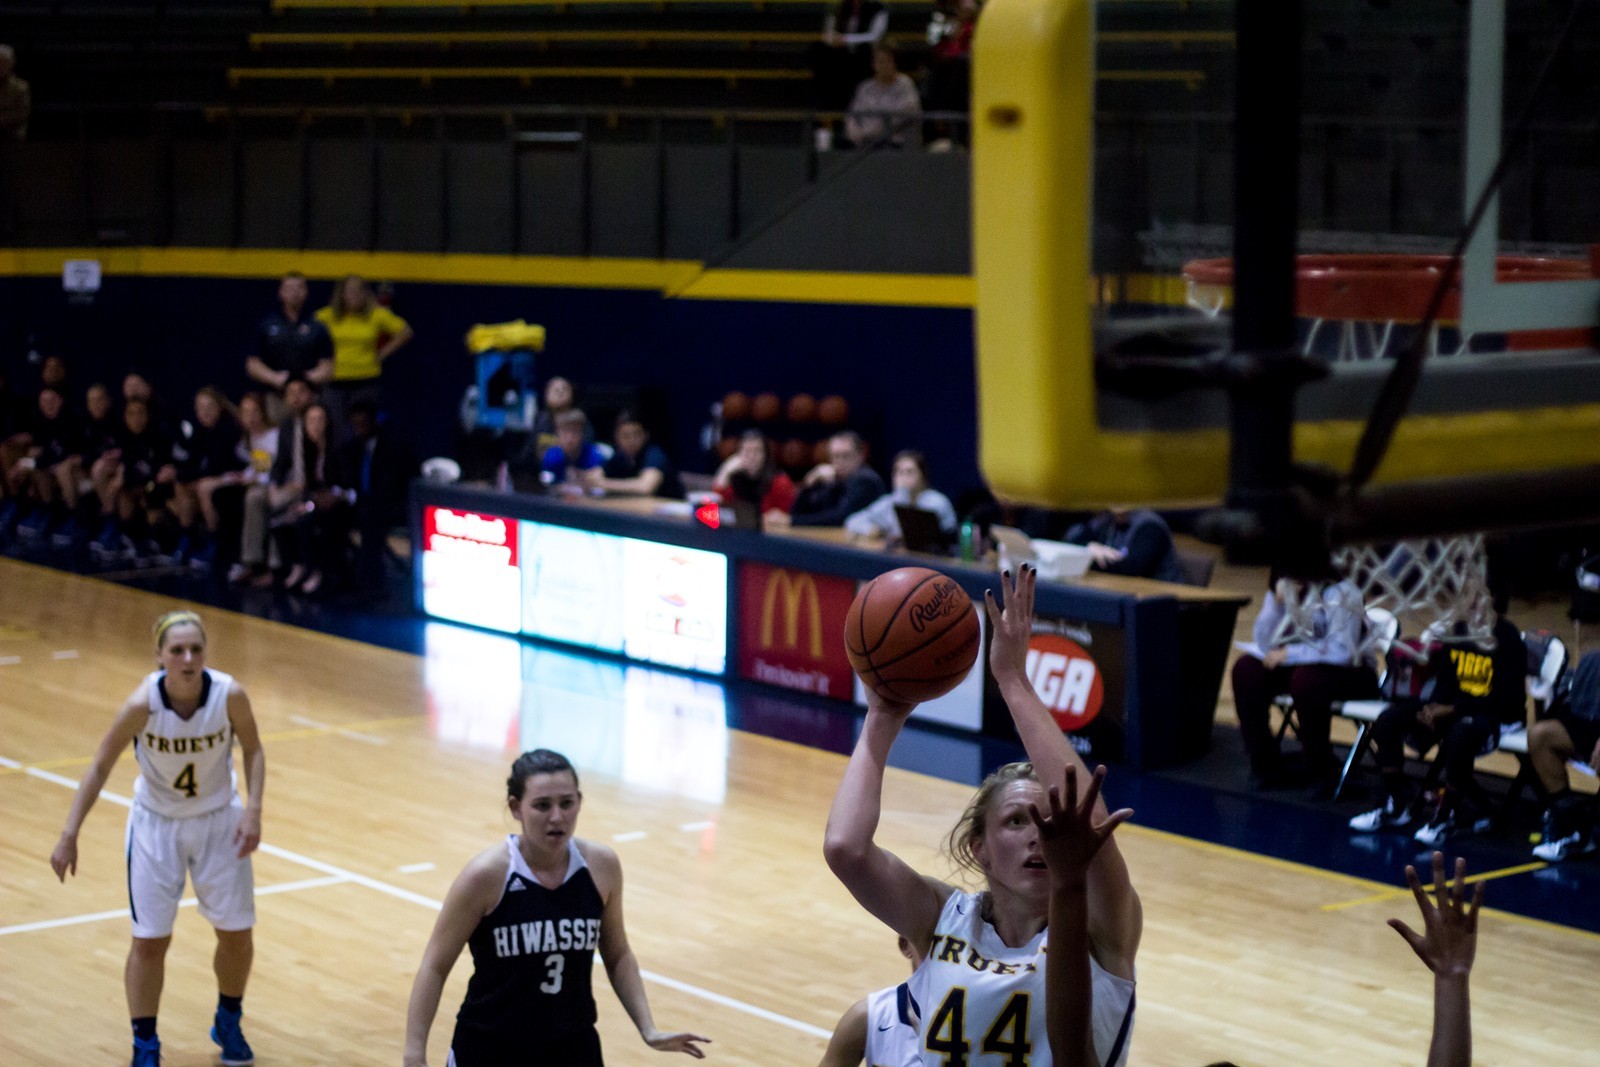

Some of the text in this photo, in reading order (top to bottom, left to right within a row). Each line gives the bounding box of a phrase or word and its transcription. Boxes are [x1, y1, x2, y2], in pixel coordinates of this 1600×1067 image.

[173, 762, 198, 798] 4
[539, 953, 565, 994] 3
[930, 934, 1047, 976] TRUE
[925, 984, 1035, 1067] 44
